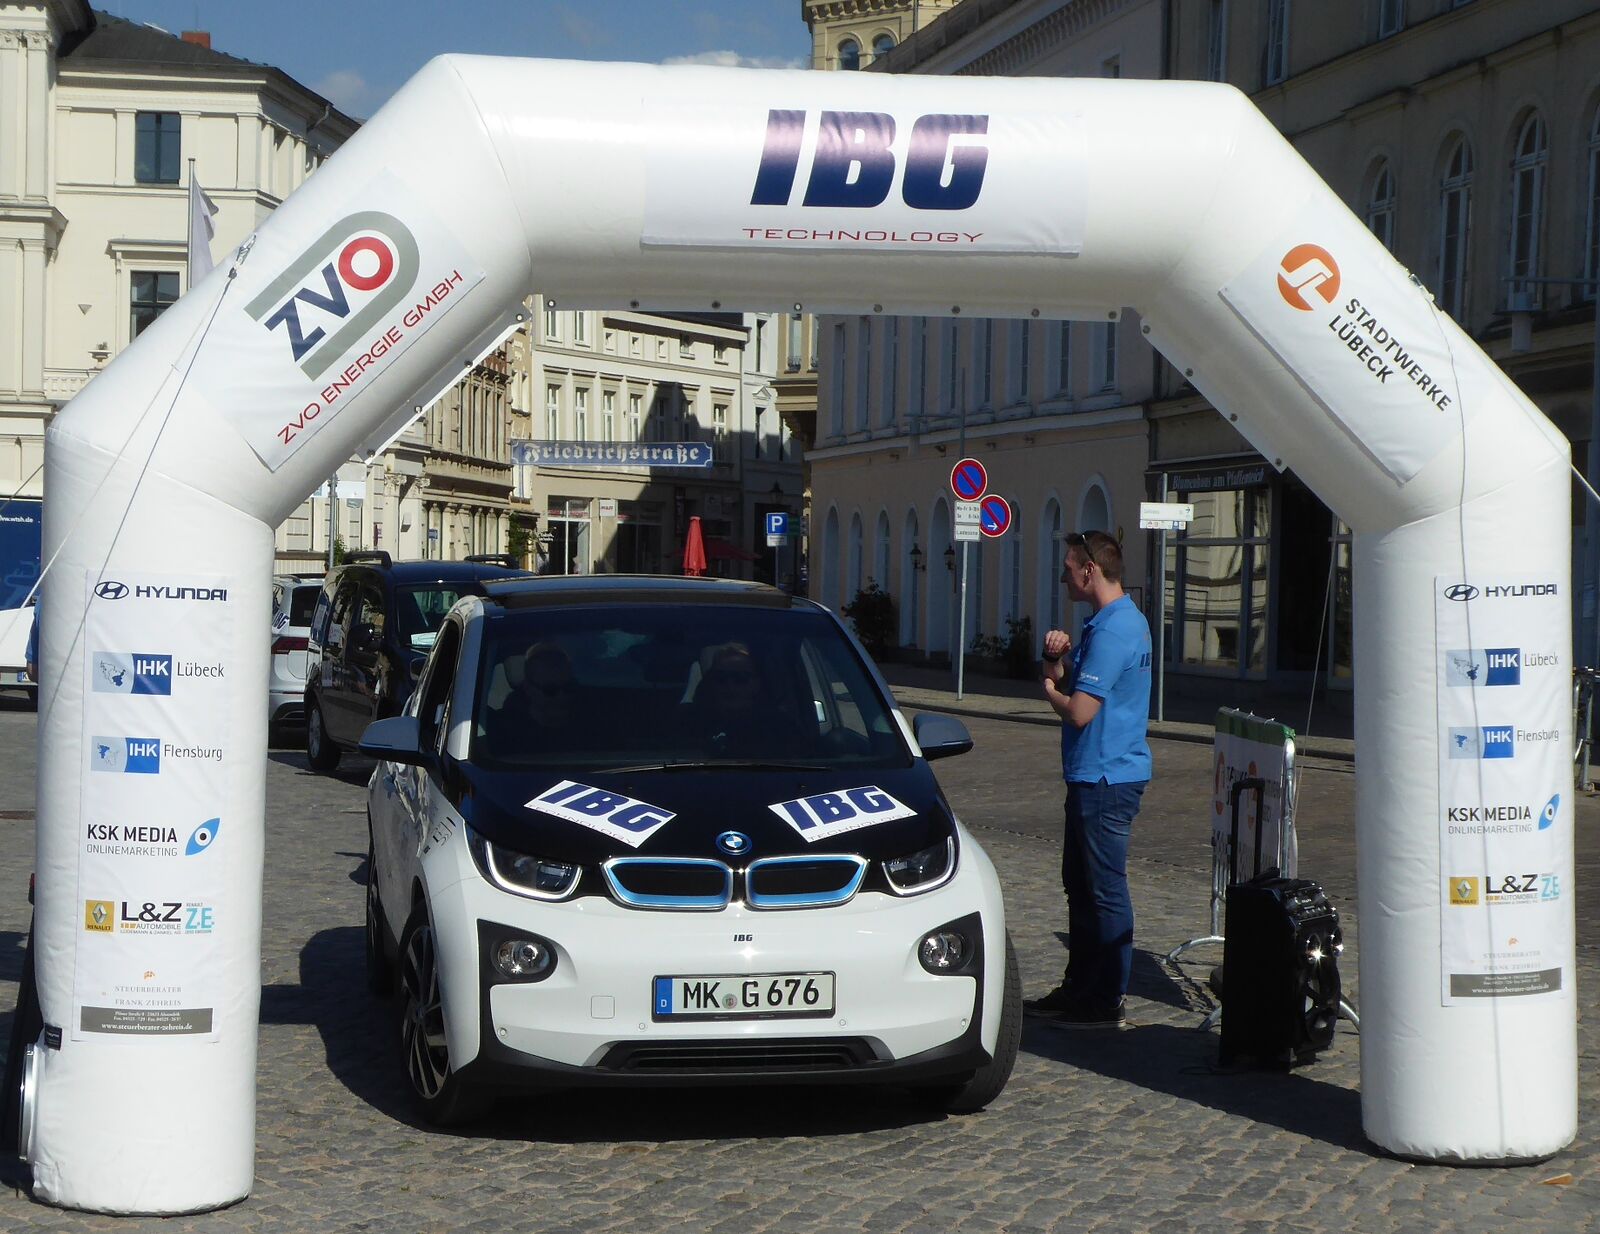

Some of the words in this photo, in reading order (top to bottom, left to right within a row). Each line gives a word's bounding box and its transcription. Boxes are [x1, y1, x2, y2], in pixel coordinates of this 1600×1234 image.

[750, 108, 989, 210] IBG
[742, 228, 984, 243] TECHNOLOGY
[264, 236, 394, 363] ZVO
[277, 402, 321, 445] ZVO
[320, 325, 403, 404] ENERGIE
[403, 269, 463, 328] GMBH
[1328, 315, 1394, 384] LÜBECK
[1345, 298, 1452, 412] STADTWERKE
[523, 443, 699, 464] Friedrichstraße
[771, 516, 783, 532] P
[136, 585, 227, 601] HYUNDAI
[1486, 584, 1558, 597] HYUNDAI
[1490, 653, 1518, 668] IHK
[1524, 652, 1559, 667] Lübeck
[136, 660, 169, 676] IHK
[177, 662, 225, 678] Lübeck
[1487, 731, 1512, 743] IHK
[1517, 729, 1559, 742] Flensburg
[129, 743, 157, 757] IHK
[164, 744, 223, 761] Flensburg
[538, 784, 675, 833] IBG
[781, 787, 896, 831] IBG
[1448, 807, 1480, 822] KSK
[1484, 806, 1531, 821] MEDIA
[87, 823, 119, 841] KSK
[123, 826, 178, 843] MEDIA
[1448, 823, 1532, 835] ONLINEMARKETING
[86, 843, 178, 857] ONLINEMARKETING
[1485, 874, 1538, 894] L&Z
[121, 901, 182, 922] L&Z
[136, 923, 181, 931] AUTOMOBILE
[733, 934, 753, 942] IBG
[114, 985, 182, 993] STEUERBERATER
[683, 981, 721, 1009] MK
[742, 981, 759, 1008] G
[767, 978, 819, 1007] 676
[661, 999, 667, 1008] D
[102, 1022, 193, 1031] www.steuerberater-zehreis.de
